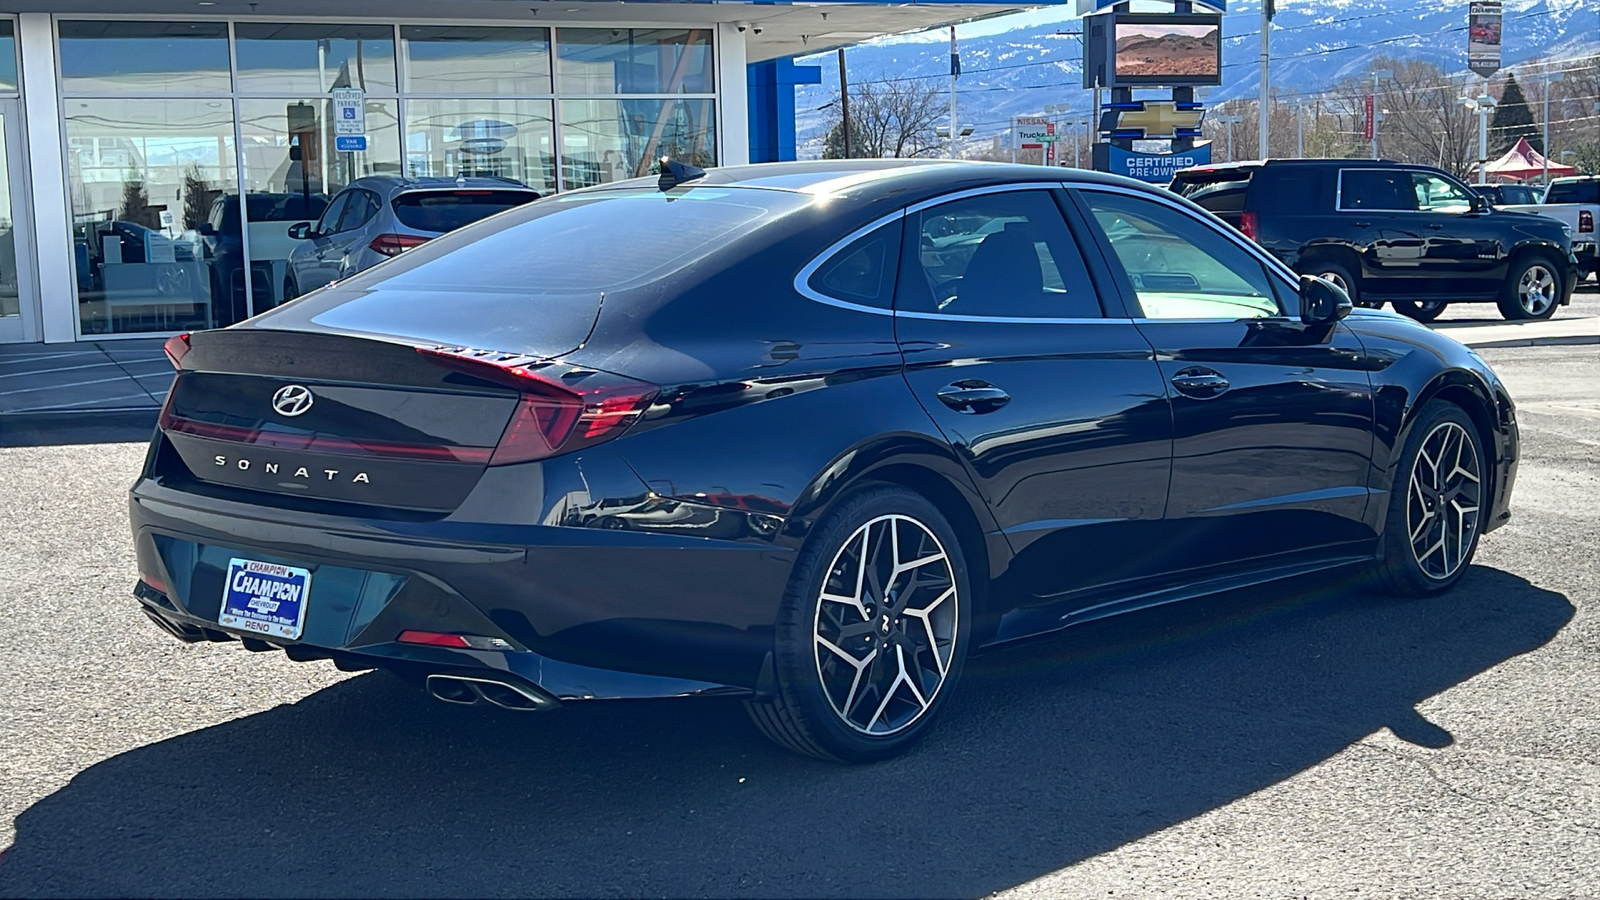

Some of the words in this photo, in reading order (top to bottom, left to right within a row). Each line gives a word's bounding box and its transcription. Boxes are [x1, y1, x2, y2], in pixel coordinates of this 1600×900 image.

[1126, 157, 1194, 167] CERTIFIED
[1130, 167, 1183, 176] PRE-OWN
[215, 455, 370, 483] SONATA
[250, 562, 287, 575] CHAMPION
[232, 571, 301, 602] CHAMPION
[251, 600, 278, 609] CHEVROLET
[245, 621, 269, 632] RENO
